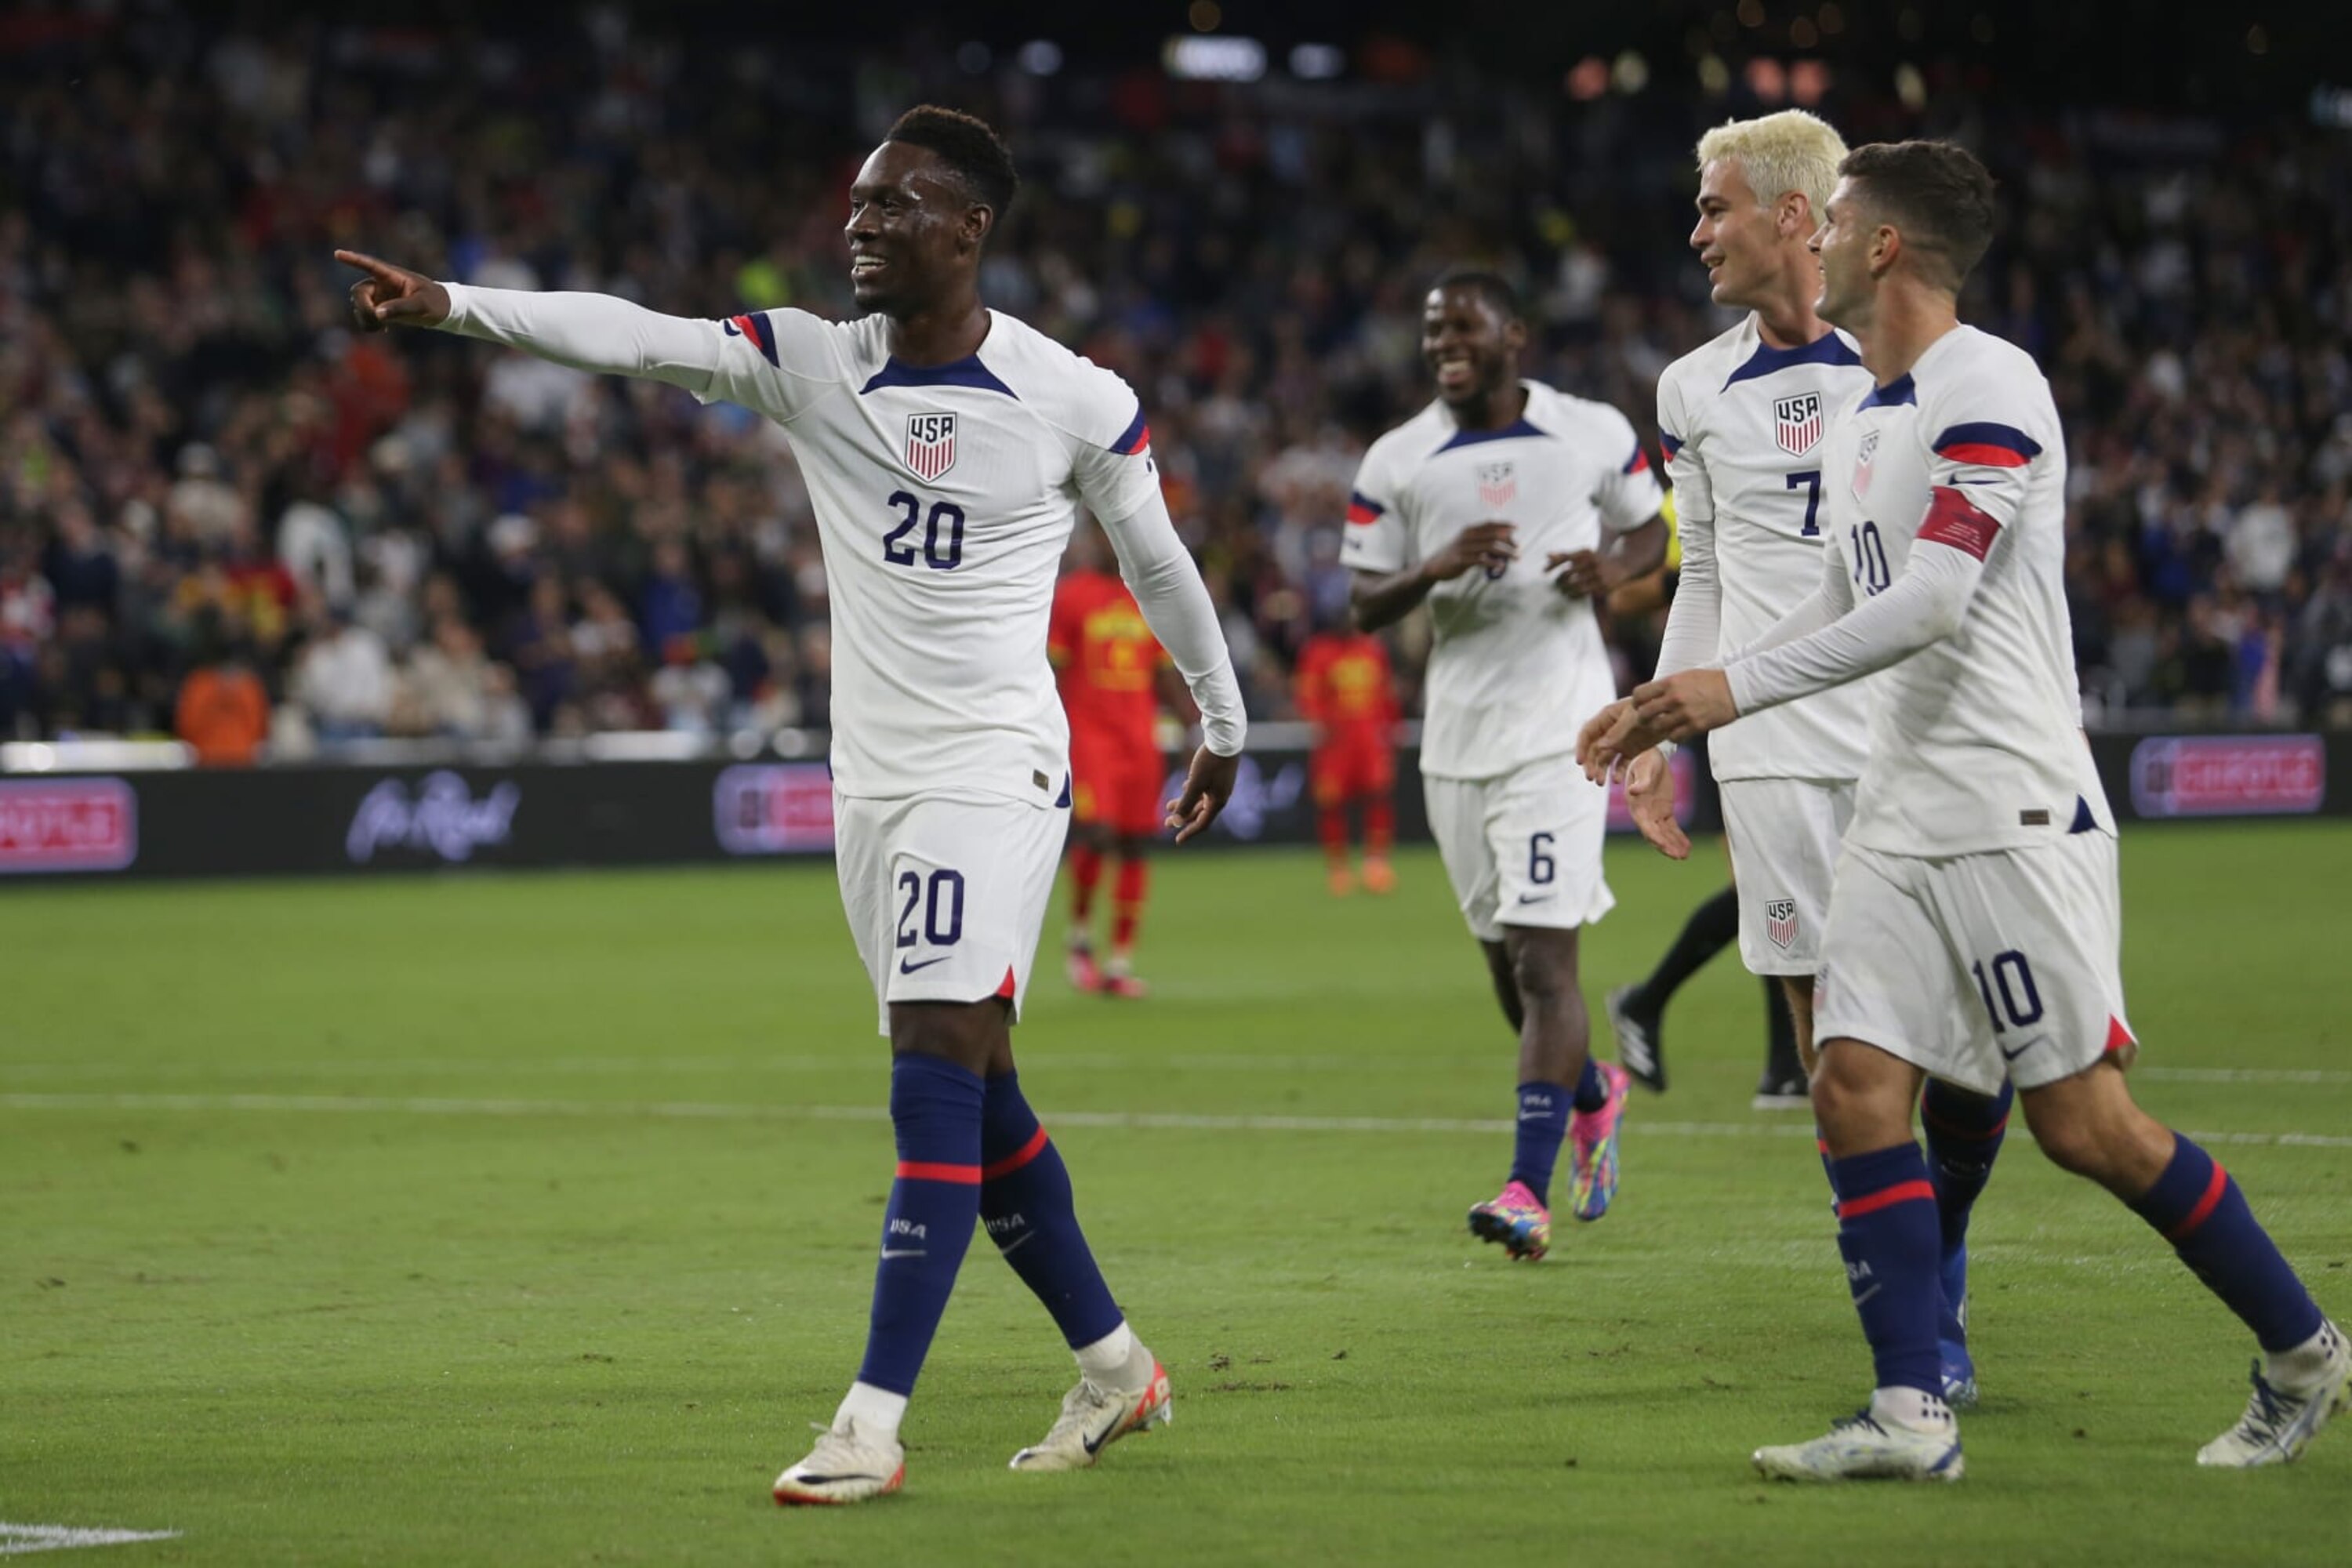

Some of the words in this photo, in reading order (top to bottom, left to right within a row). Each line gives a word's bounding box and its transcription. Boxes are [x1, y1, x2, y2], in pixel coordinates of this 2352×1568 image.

[911, 416, 953, 443] USA
[1778, 396, 1818, 423] USA
[883, 489, 965, 570] 20
[1786, 470, 1821, 536] 7
[1851, 520, 1891, 596] 10
[1530, 832, 1555, 884] 6
[896, 869, 965, 949] 20
[1769, 902, 1794, 920] USA
[1972, 949, 2044, 1034] 10
